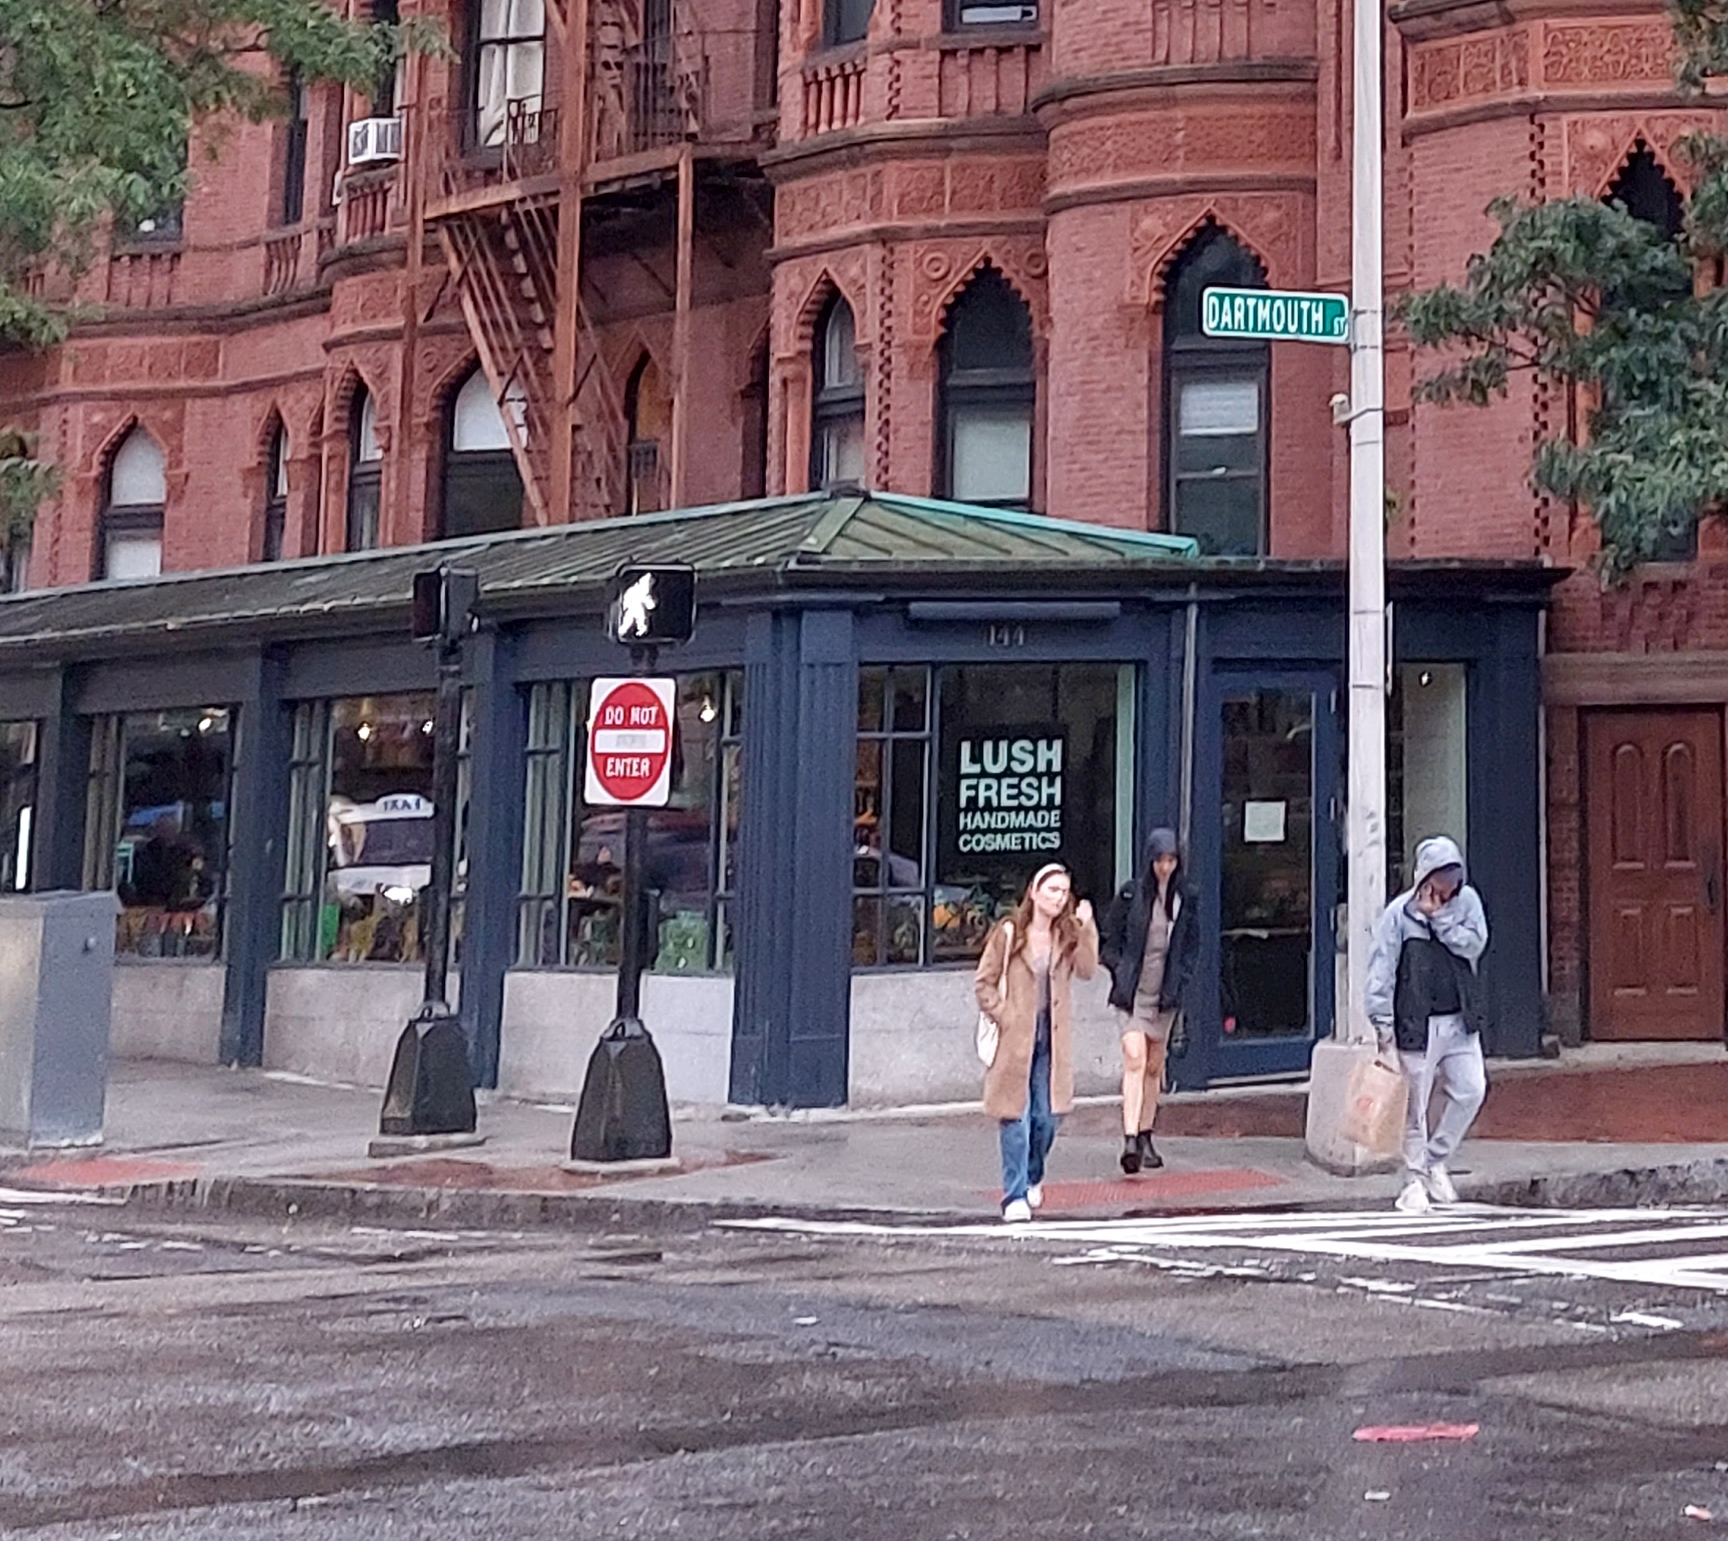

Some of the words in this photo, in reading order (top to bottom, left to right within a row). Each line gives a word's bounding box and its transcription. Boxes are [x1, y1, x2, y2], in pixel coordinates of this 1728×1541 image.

[1208, 296, 1324, 333] DARTMOUTH
[605, 706, 624, 725] DO
[630, 706, 658, 725] NOT
[606, 757, 650, 778] ENTER
[960, 740, 1062, 774] LUSH
[959, 776, 1061, 808] FRESH
[960, 810, 1061, 830] HANDMADE
[959, 831, 1061, 852] COSMETICS
